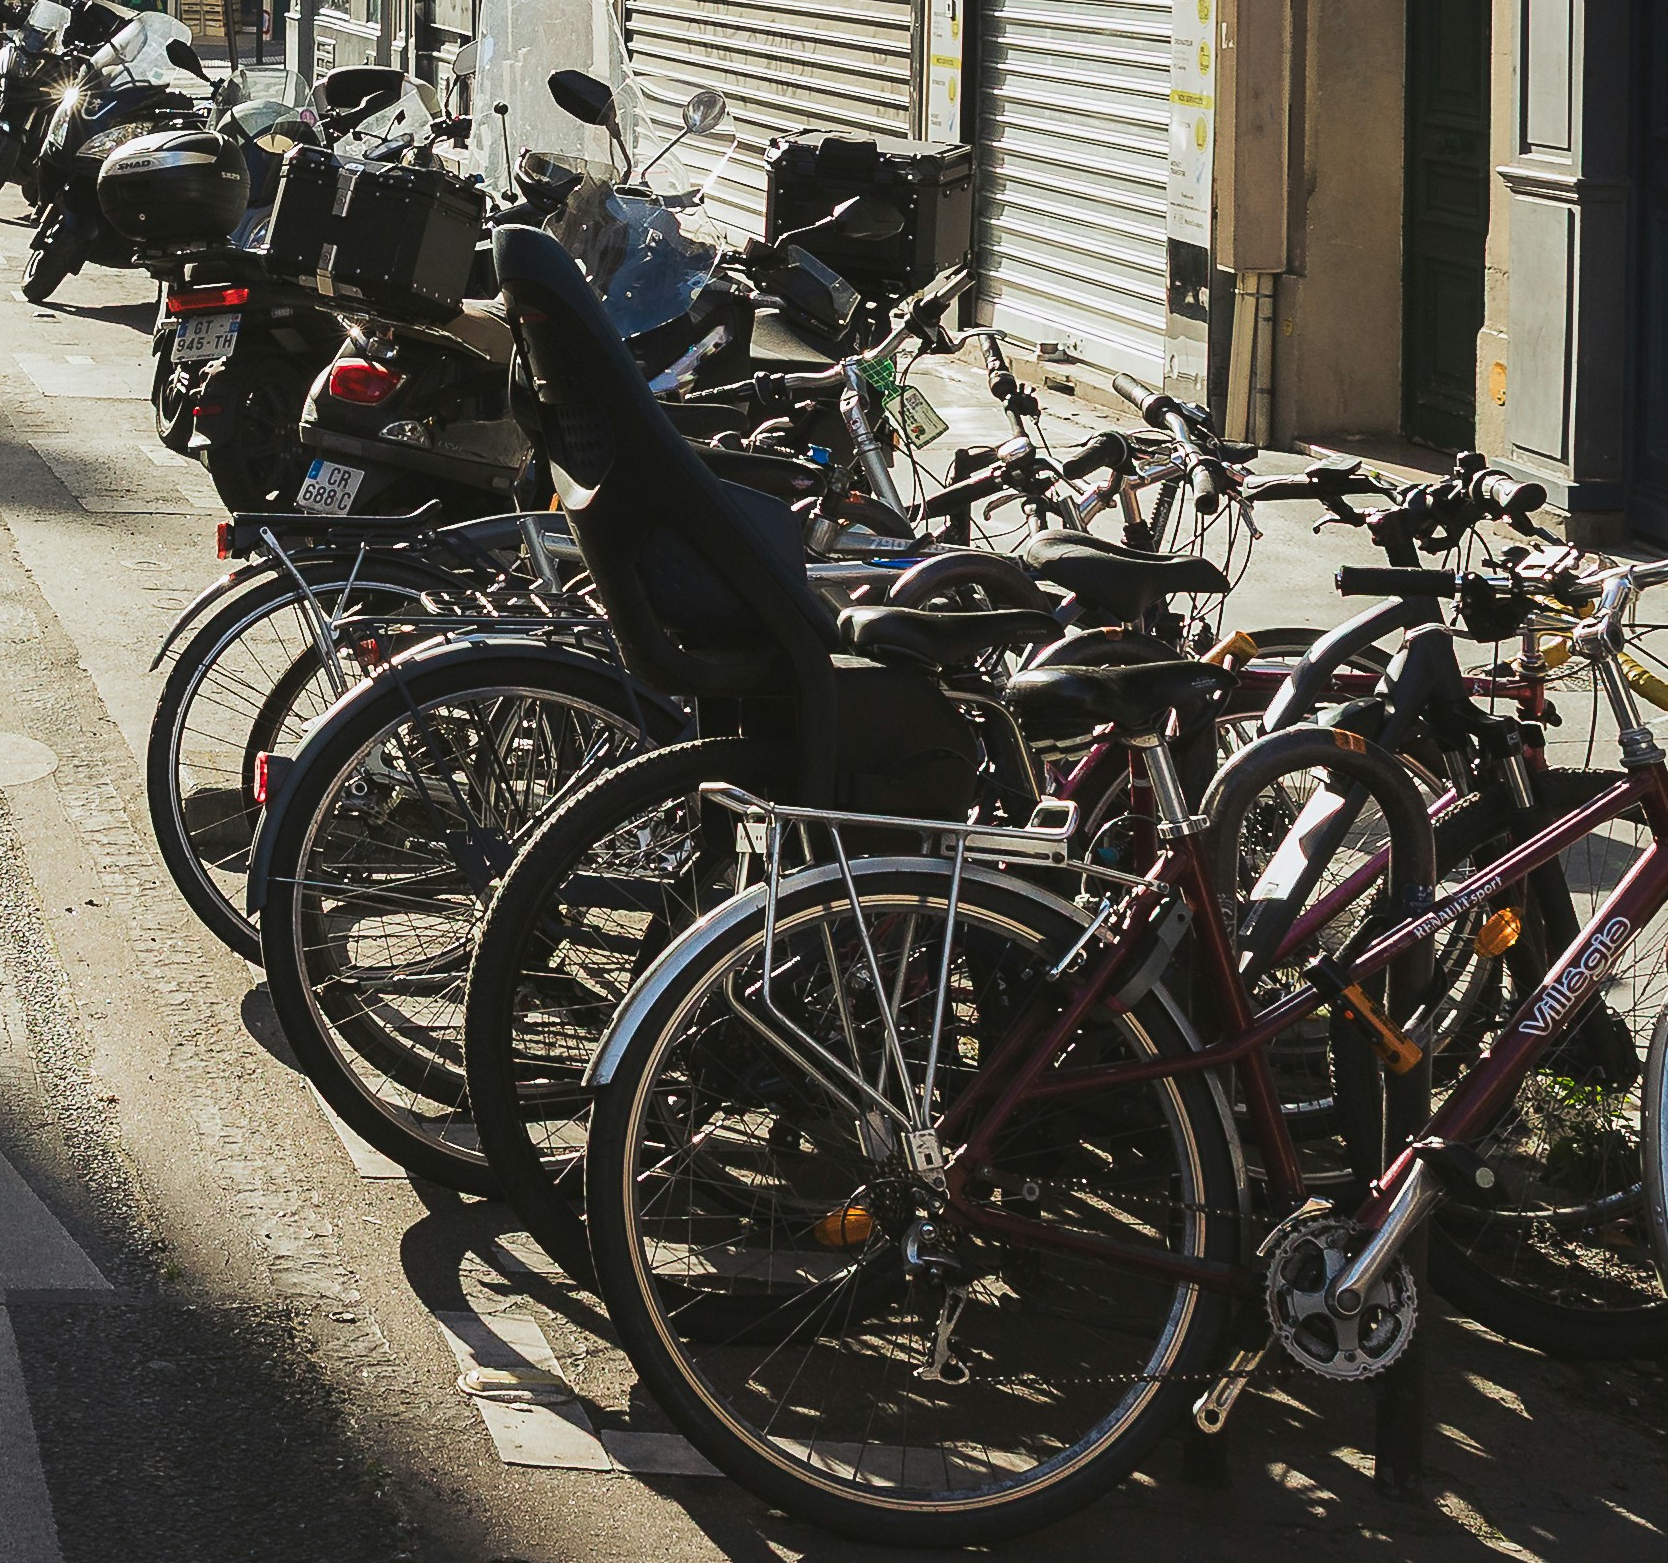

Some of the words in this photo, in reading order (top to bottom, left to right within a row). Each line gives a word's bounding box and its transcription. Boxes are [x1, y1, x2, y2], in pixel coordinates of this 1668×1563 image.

[117, 159, 151, 171] SHAD
[175, 333, 234, 354] 945-TH
[327, 466, 352, 490] CR
[1412, 893, 1471, 940] RENAULT
[1467, 874, 1503, 908] sport
[1518, 914, 1632, 1038] Villégia
